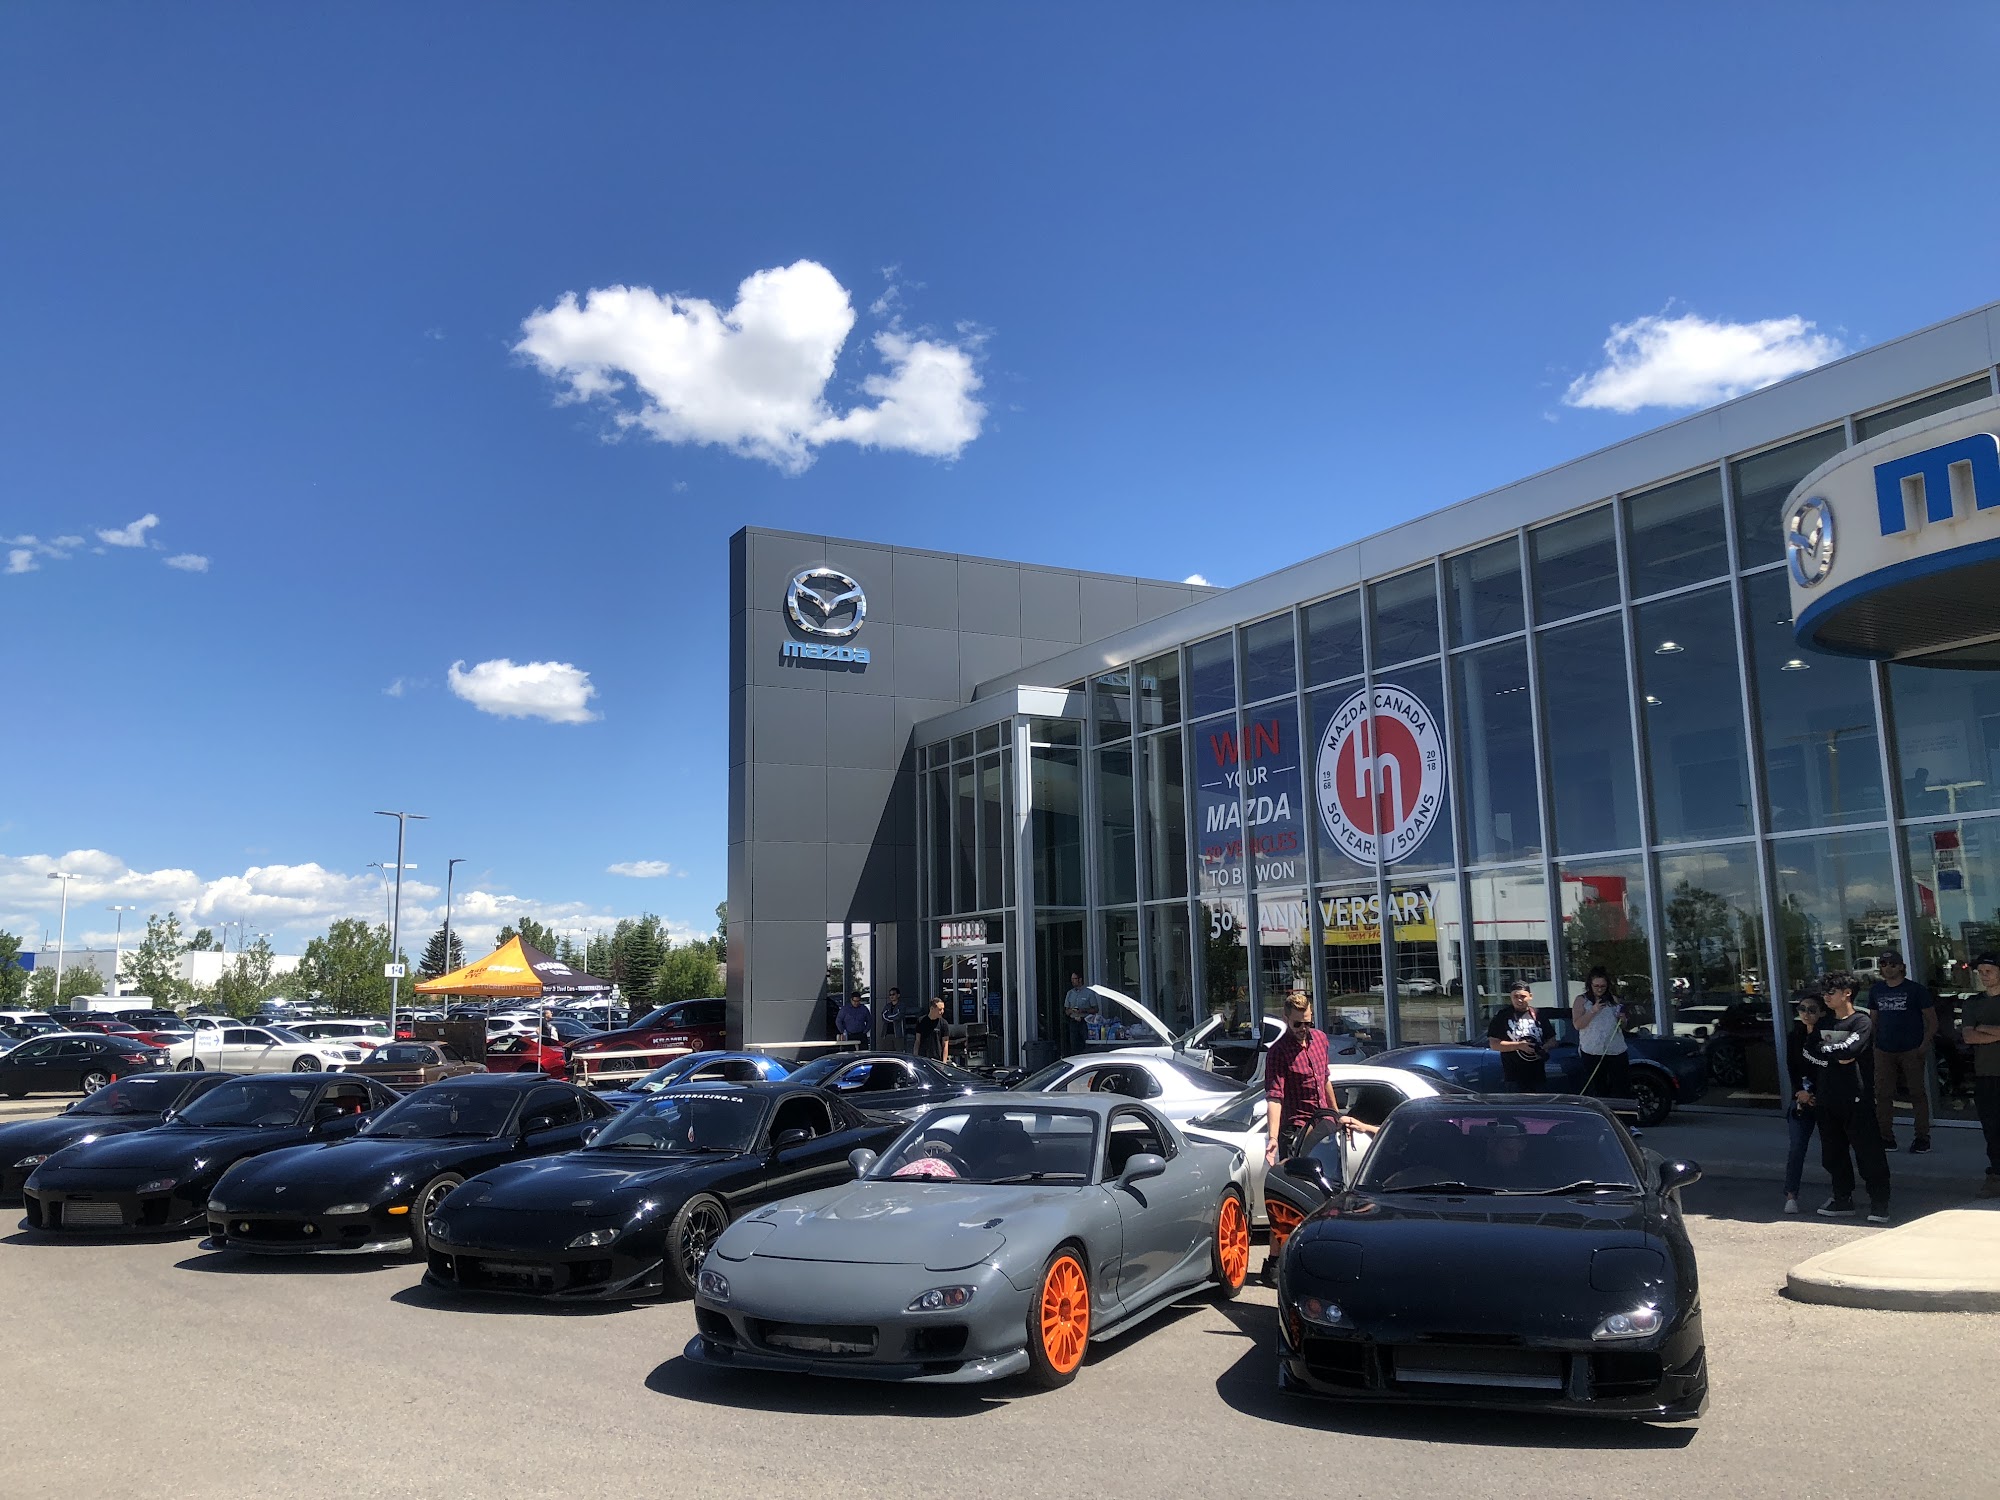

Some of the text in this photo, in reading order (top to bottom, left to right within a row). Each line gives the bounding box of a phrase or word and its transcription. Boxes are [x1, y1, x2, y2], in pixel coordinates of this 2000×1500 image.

[783, 640, 870, 664] mazda
[1327, 694, 1426, 751] MAZDA CANADA
[1210, 719, 1281, 768] WIN
[1426, 750, 1436, 759] 20
[1426, 762, 1436, 771] 18
[1206, 792, 1291, 833] MAZDA
[1327, 802, 1341, 825] 50
[1413, 793, 1434, 833] ANS
[1209, 868, 1229, 887] TO
[1255, 860, 1295, 882] WON
[1257, 889, 1440, 932] ANNVERSARY
[653, 1036, 688, 1044] KRAMER
